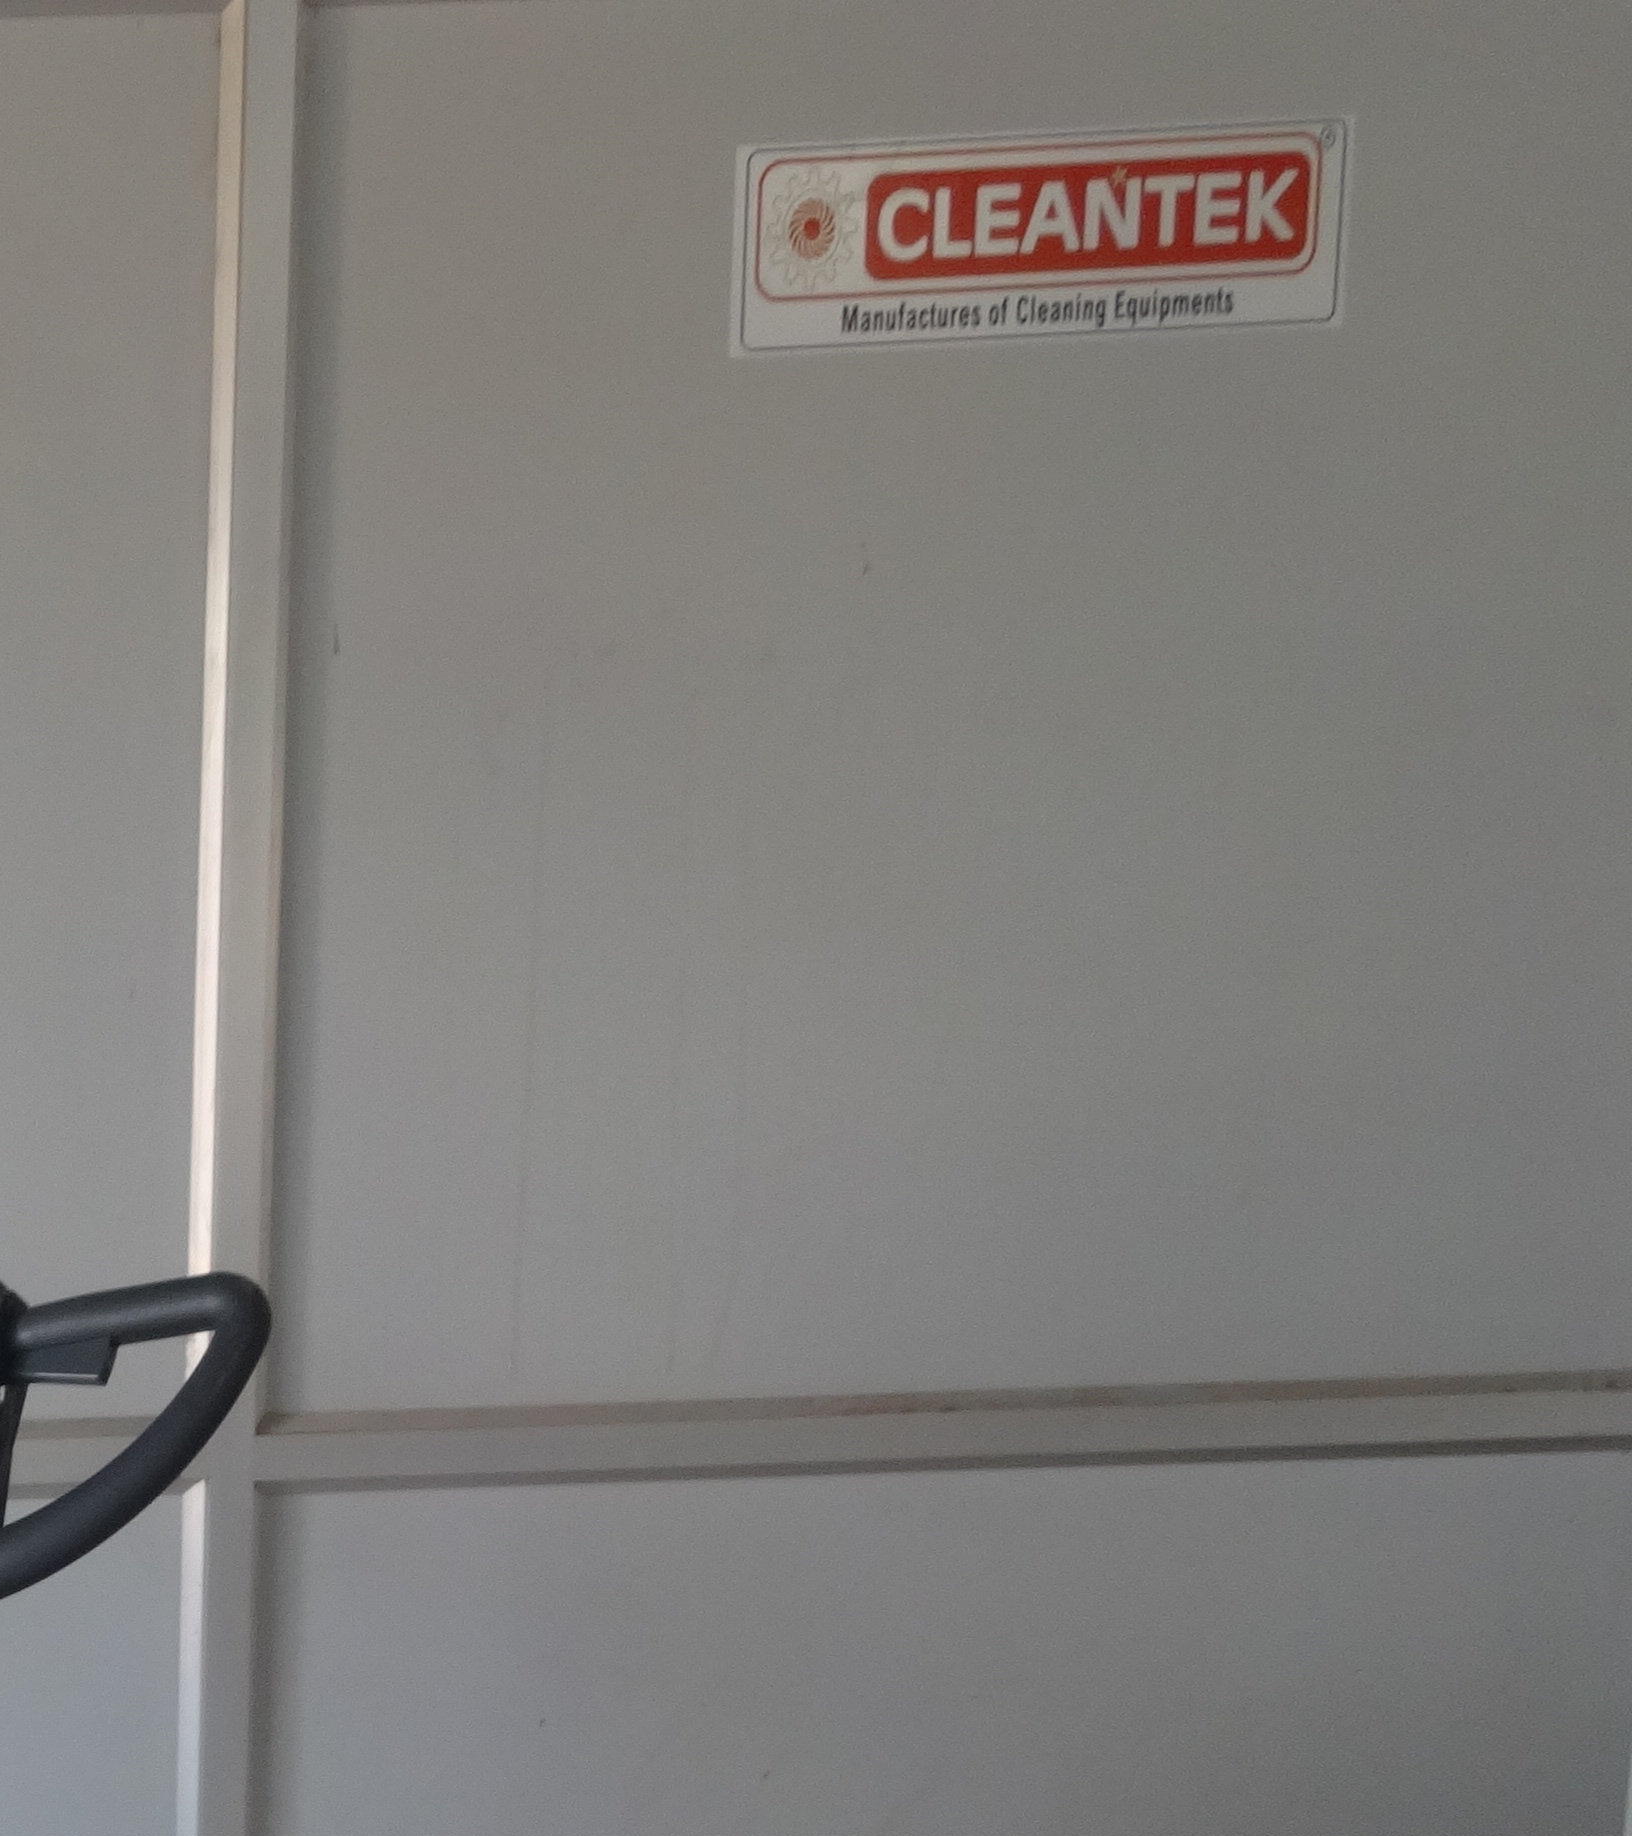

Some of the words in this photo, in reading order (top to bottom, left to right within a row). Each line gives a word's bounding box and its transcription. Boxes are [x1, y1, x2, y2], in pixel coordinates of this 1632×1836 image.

[876, 168, 1299, 263] CLEANTEK
[841, 301, 982, 334] Manufactures
[989, 297, 1010, 326] of
[1016, 293, 1106, 328] Cleaning
[1114, 289, 1234, 324] Equipments
